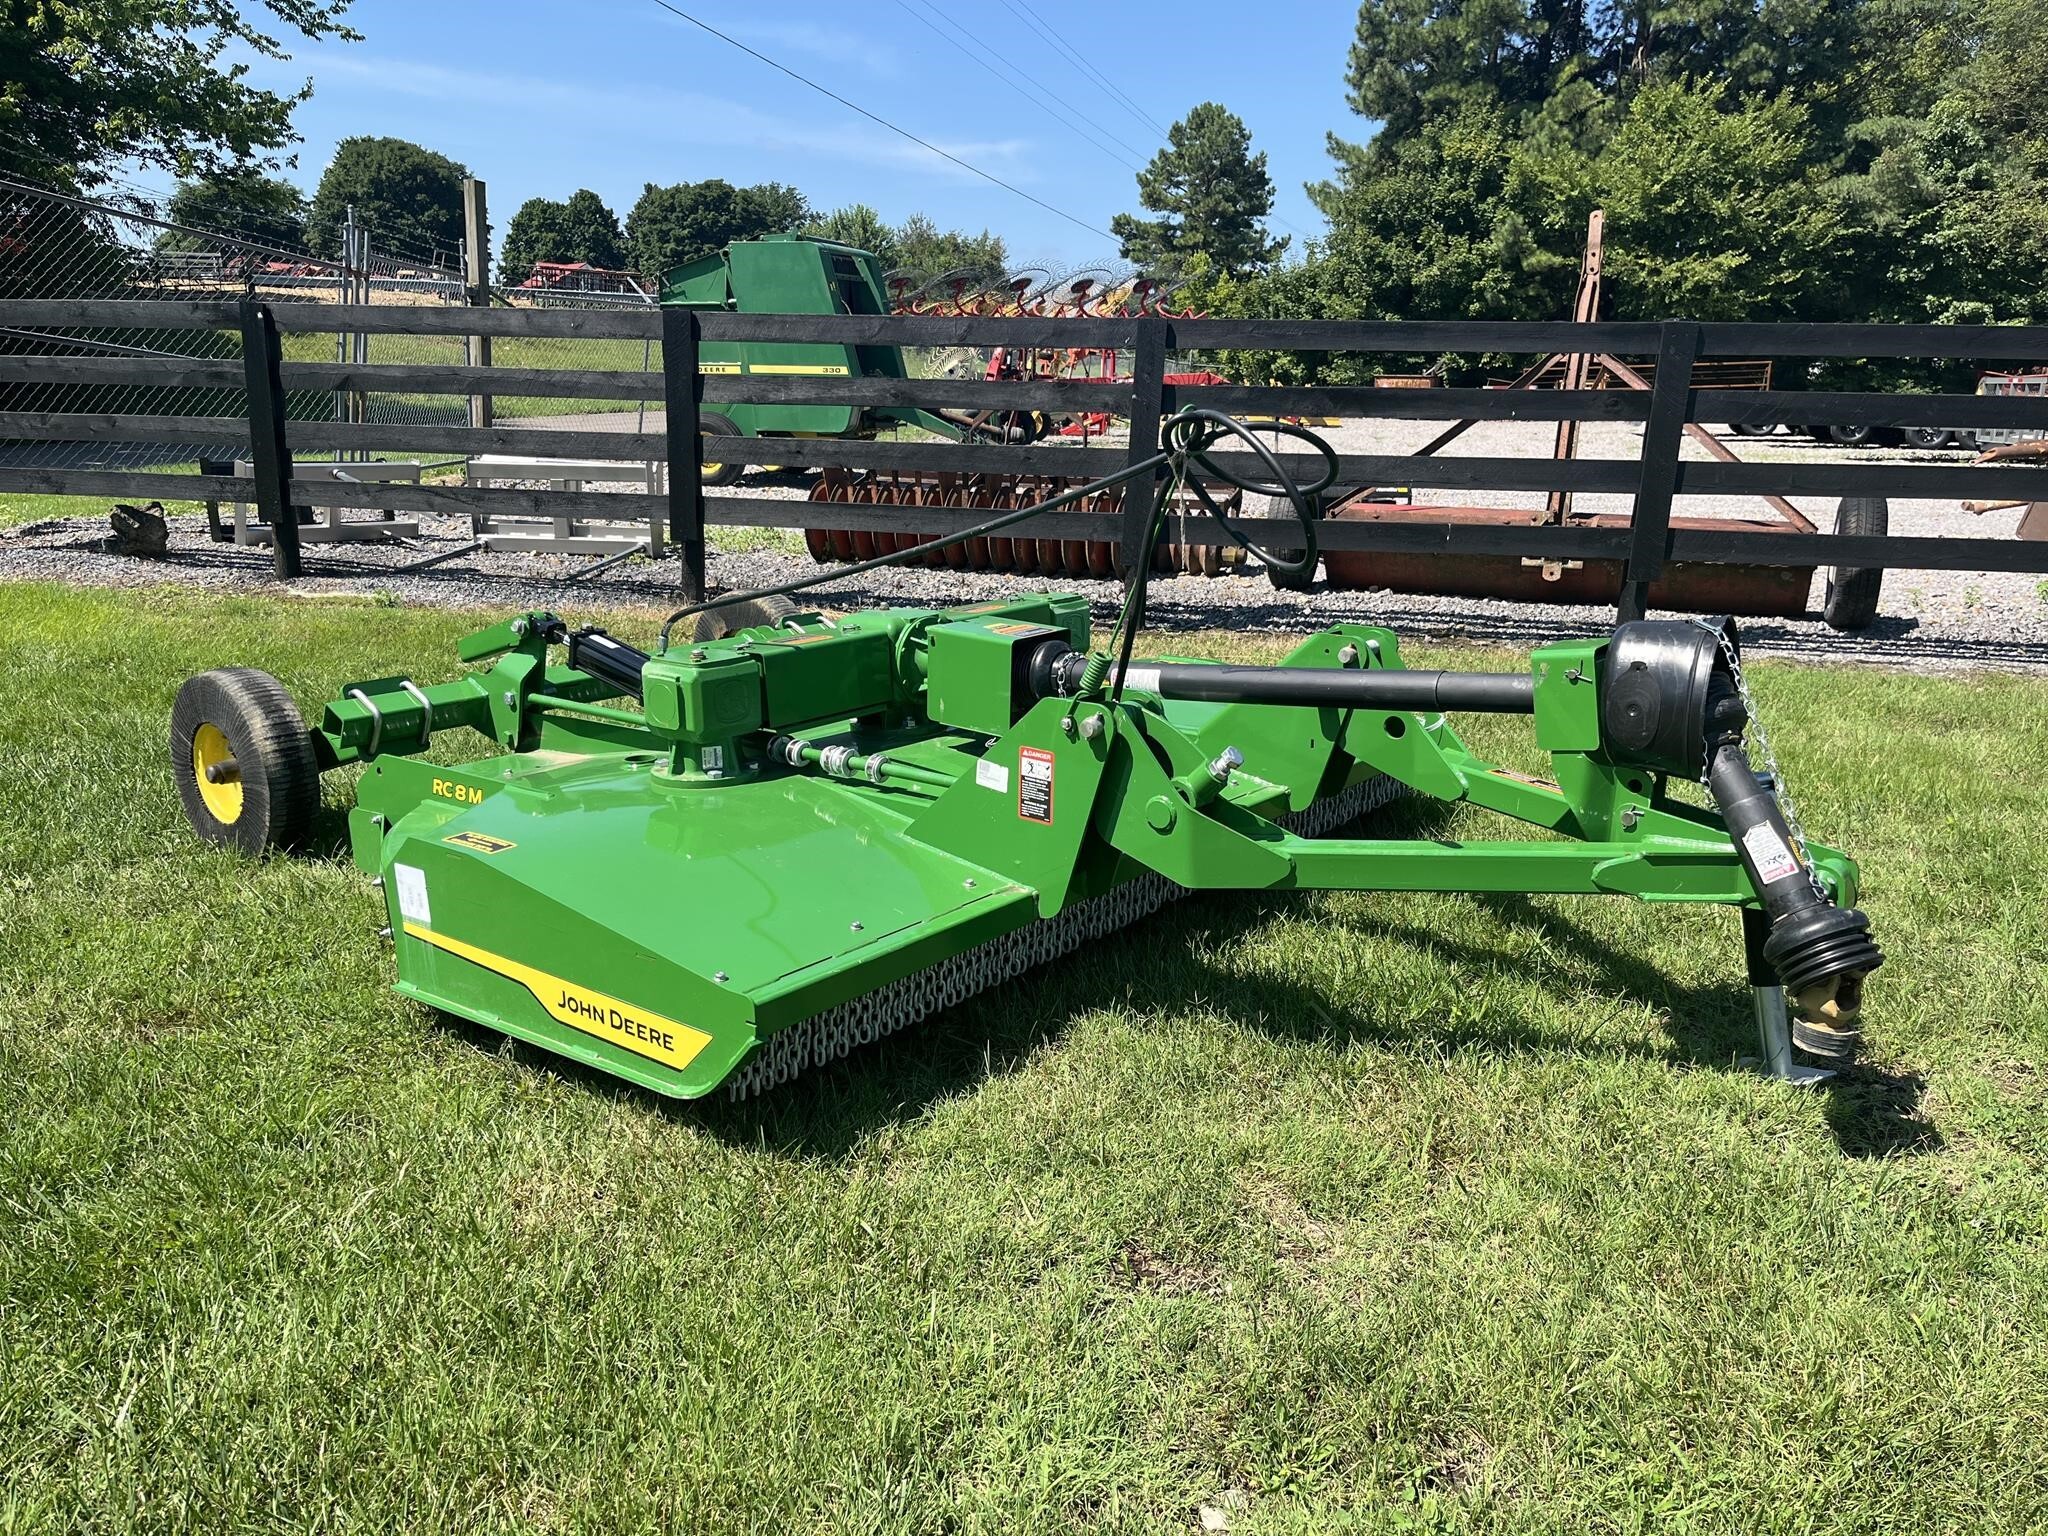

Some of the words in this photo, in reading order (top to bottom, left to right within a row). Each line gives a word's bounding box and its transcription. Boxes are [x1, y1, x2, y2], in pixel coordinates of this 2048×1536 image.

[1027, 749, 1052, 761] DANGER
[557, 990, 605, 1025] JOHN
[609, 1008, 675, 1052] DEERE
